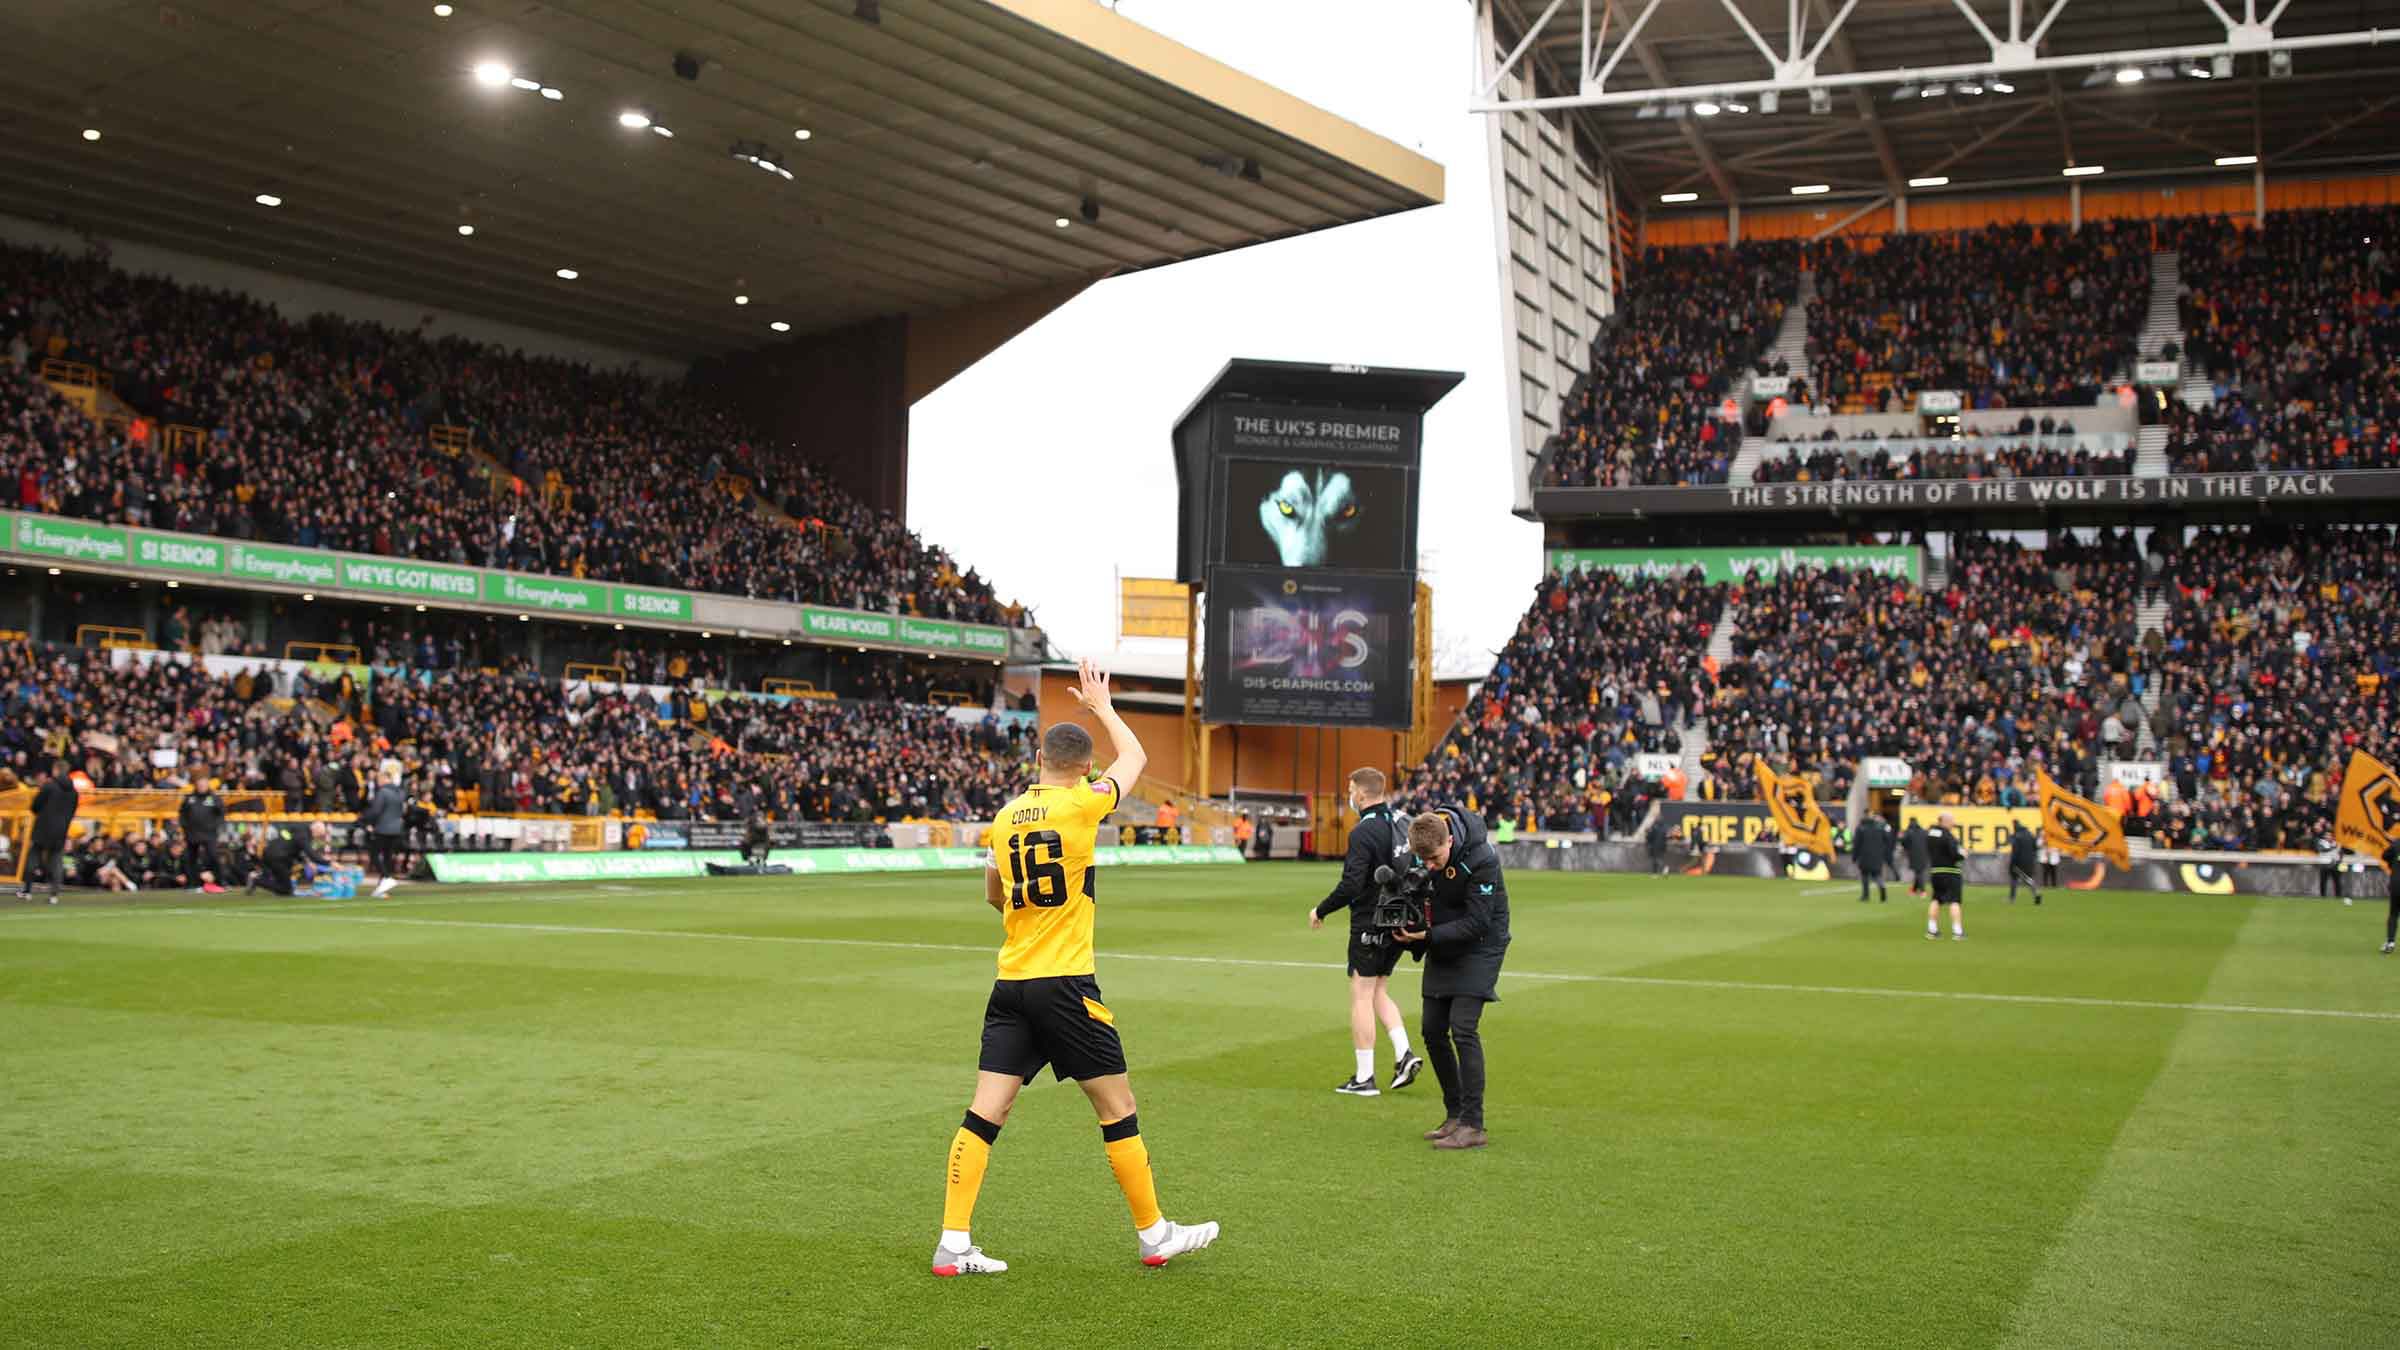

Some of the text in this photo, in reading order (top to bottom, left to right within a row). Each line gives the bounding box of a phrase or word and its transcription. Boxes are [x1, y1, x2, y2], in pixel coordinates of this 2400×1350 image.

[1234, 416, 1400, 441] THE UK'S PREMIER
[1729, 474, 2335, 506] THE STRENGTH OF THE WOLF IS IN THE PACK
[141, 540, 217, 567] SI SENOR
[1870, 555, 1908, 577] WE
[346, 564, 475, 595] WE'VE GOT NEVES
[624, 593, 680, 615] SI SENOR
[1250, 607, 1369, 668] DIS
[1243, 676, 1375, 692] DIS-GRAPHICS.COM
[1012, 807, 1048, 825] COADY
[1009, 829, 1069, 910] 16
